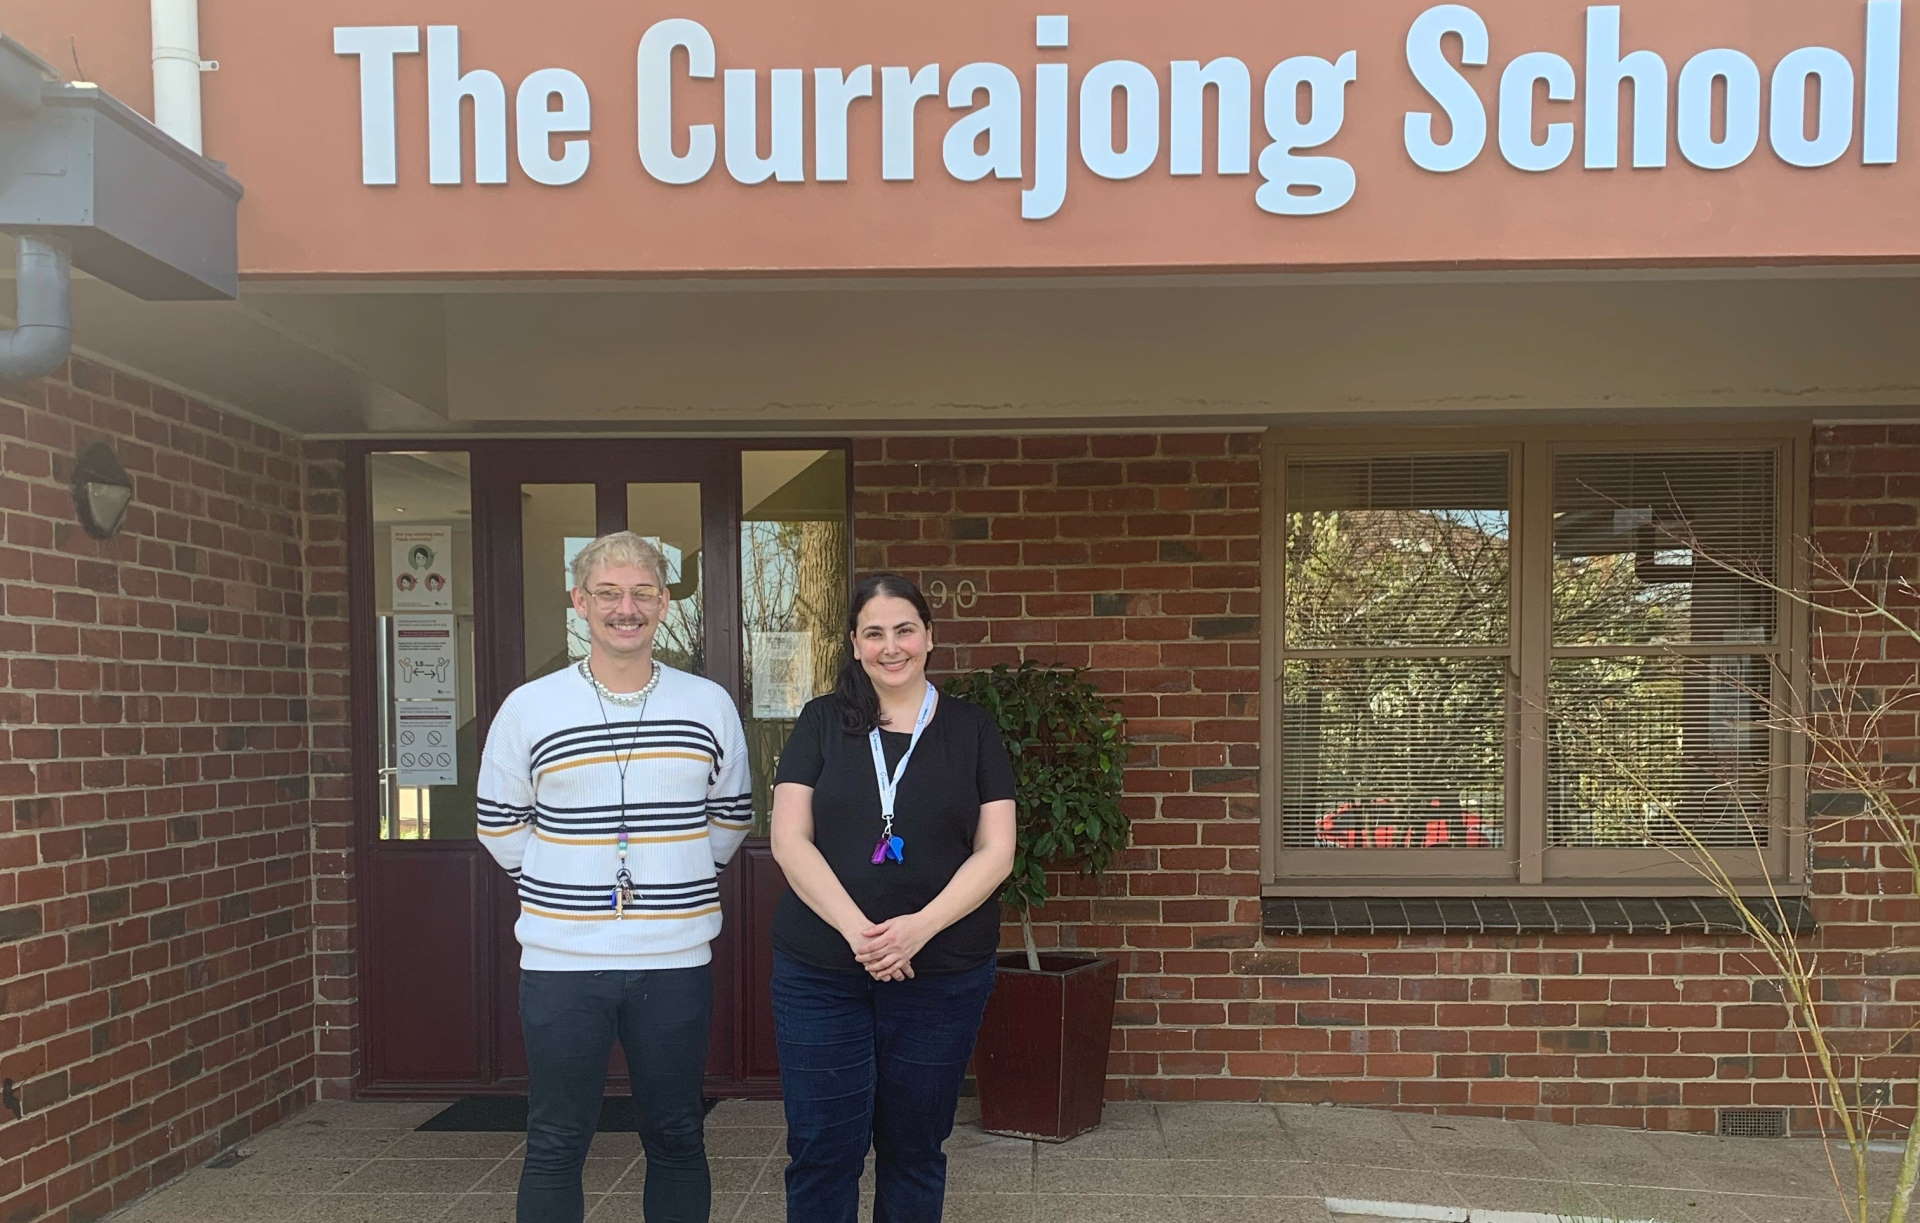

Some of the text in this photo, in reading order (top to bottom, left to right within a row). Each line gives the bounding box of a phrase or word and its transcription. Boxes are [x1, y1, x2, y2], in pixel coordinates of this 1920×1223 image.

[333, 0, 1903, 221] The Currajong School
[930, 579, 977, 609] 90
